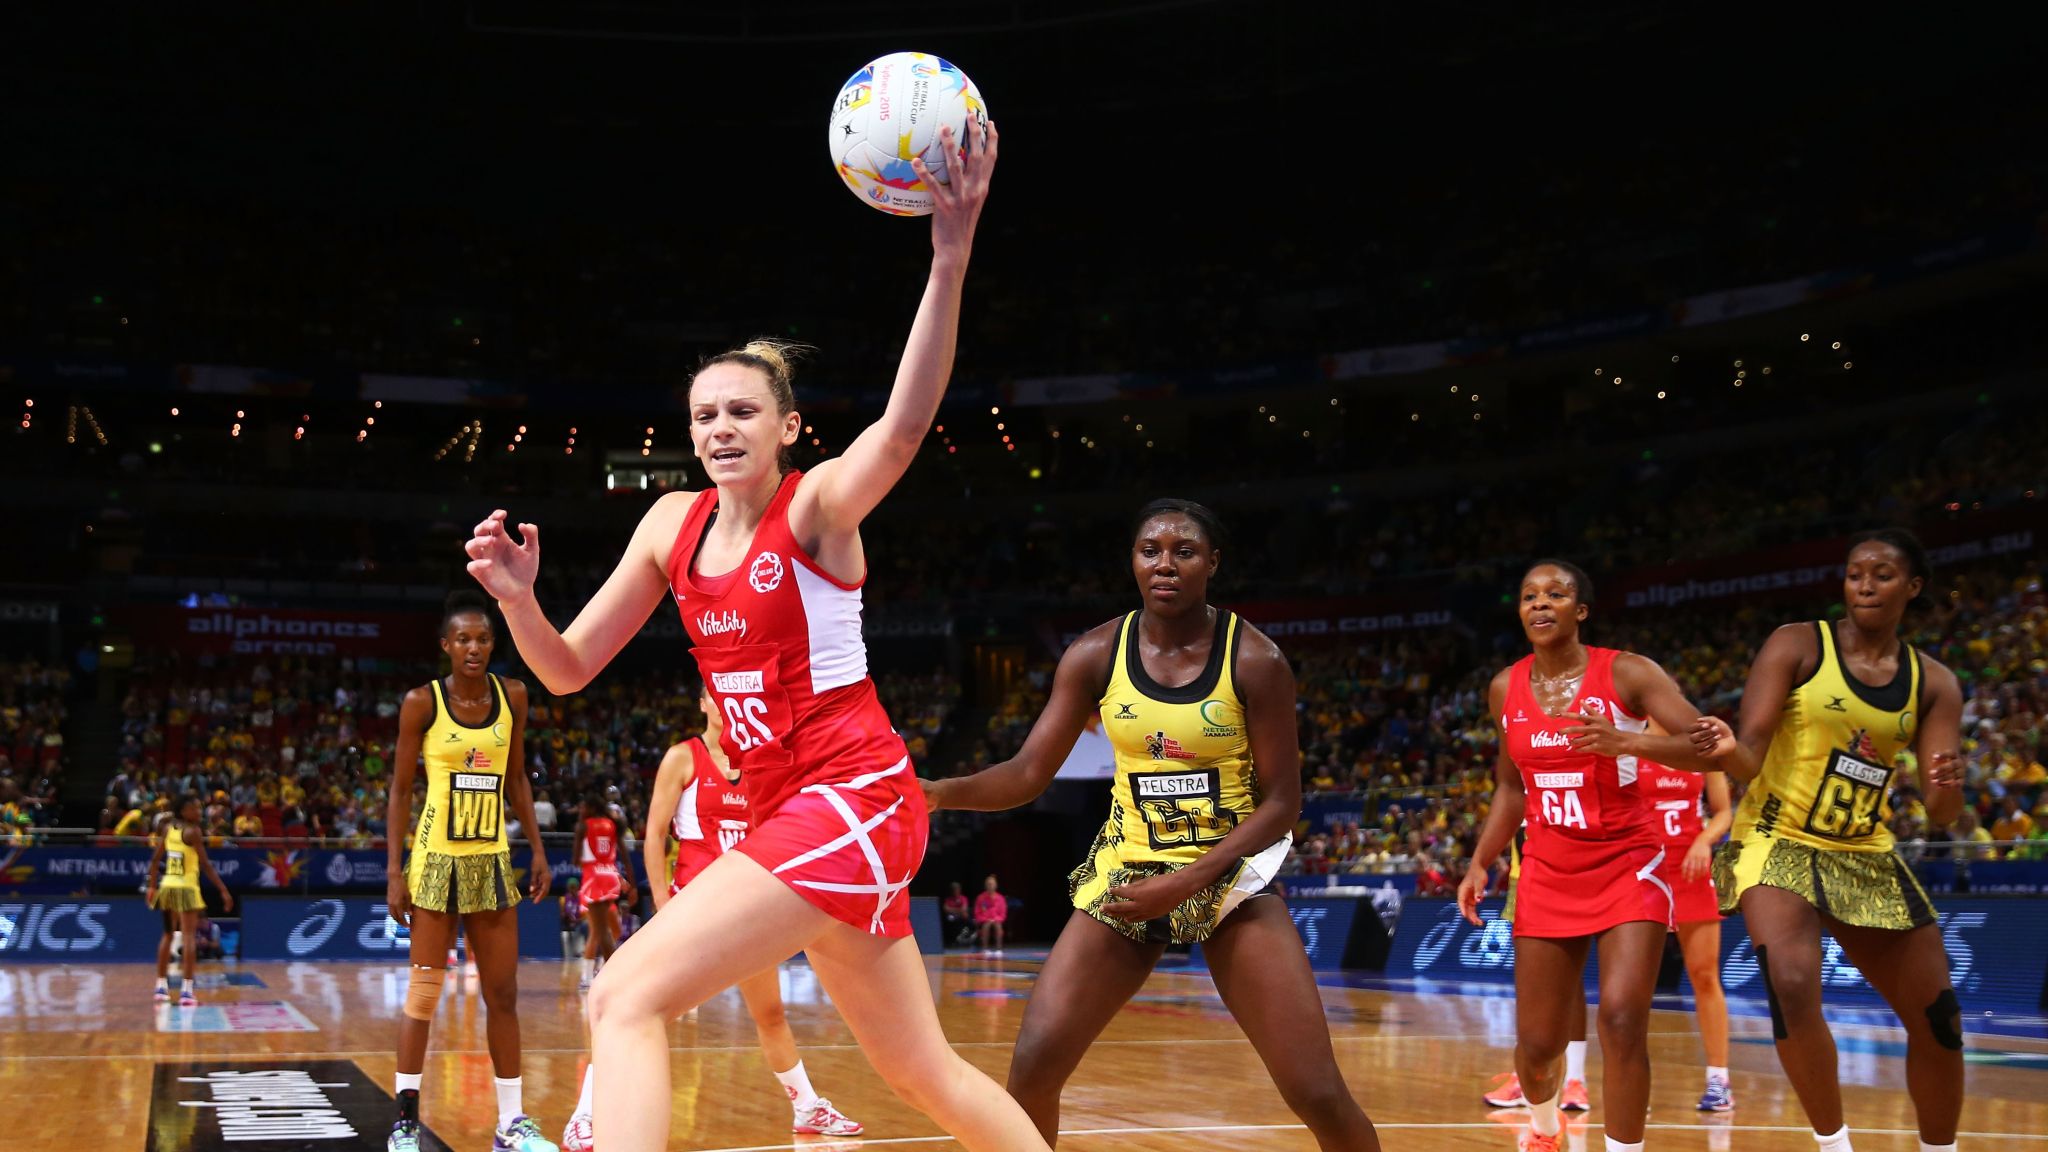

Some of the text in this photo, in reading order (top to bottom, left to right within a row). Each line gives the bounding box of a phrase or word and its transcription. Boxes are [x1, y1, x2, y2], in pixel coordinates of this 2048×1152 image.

[879, 95, 890, 121] 2015
[910, 80, 920, 125] WORLD CUP
[918, 80, 928, 112] NETBALL
[186, 613, 381, 638] allphones
[697, 609, 747, 638] Vitality
[232, 639, 337, 656] arena
[713, 674, 761, 691] TELSTRA
[723, 697, 775, 751] GS
[459, 777, 496, 787] TELSTRA
[1536, 775, 1582, 787] TELSTRA
[1839, 758, 1885, 783] TELSTRA
[1141, 777, 1206, 794] TELSTRA
[722, 791, 748, 810] Vitality
[1541, 789, 1588, 830] GA
[1811, 774, 1880, 836] GK
[452, 789, 499, 839] WD
[1663, 810, 1681, 836] C
[48, 858, 129, 876] NETBALL
[176, 1069, 358, 1142] sydney.com
